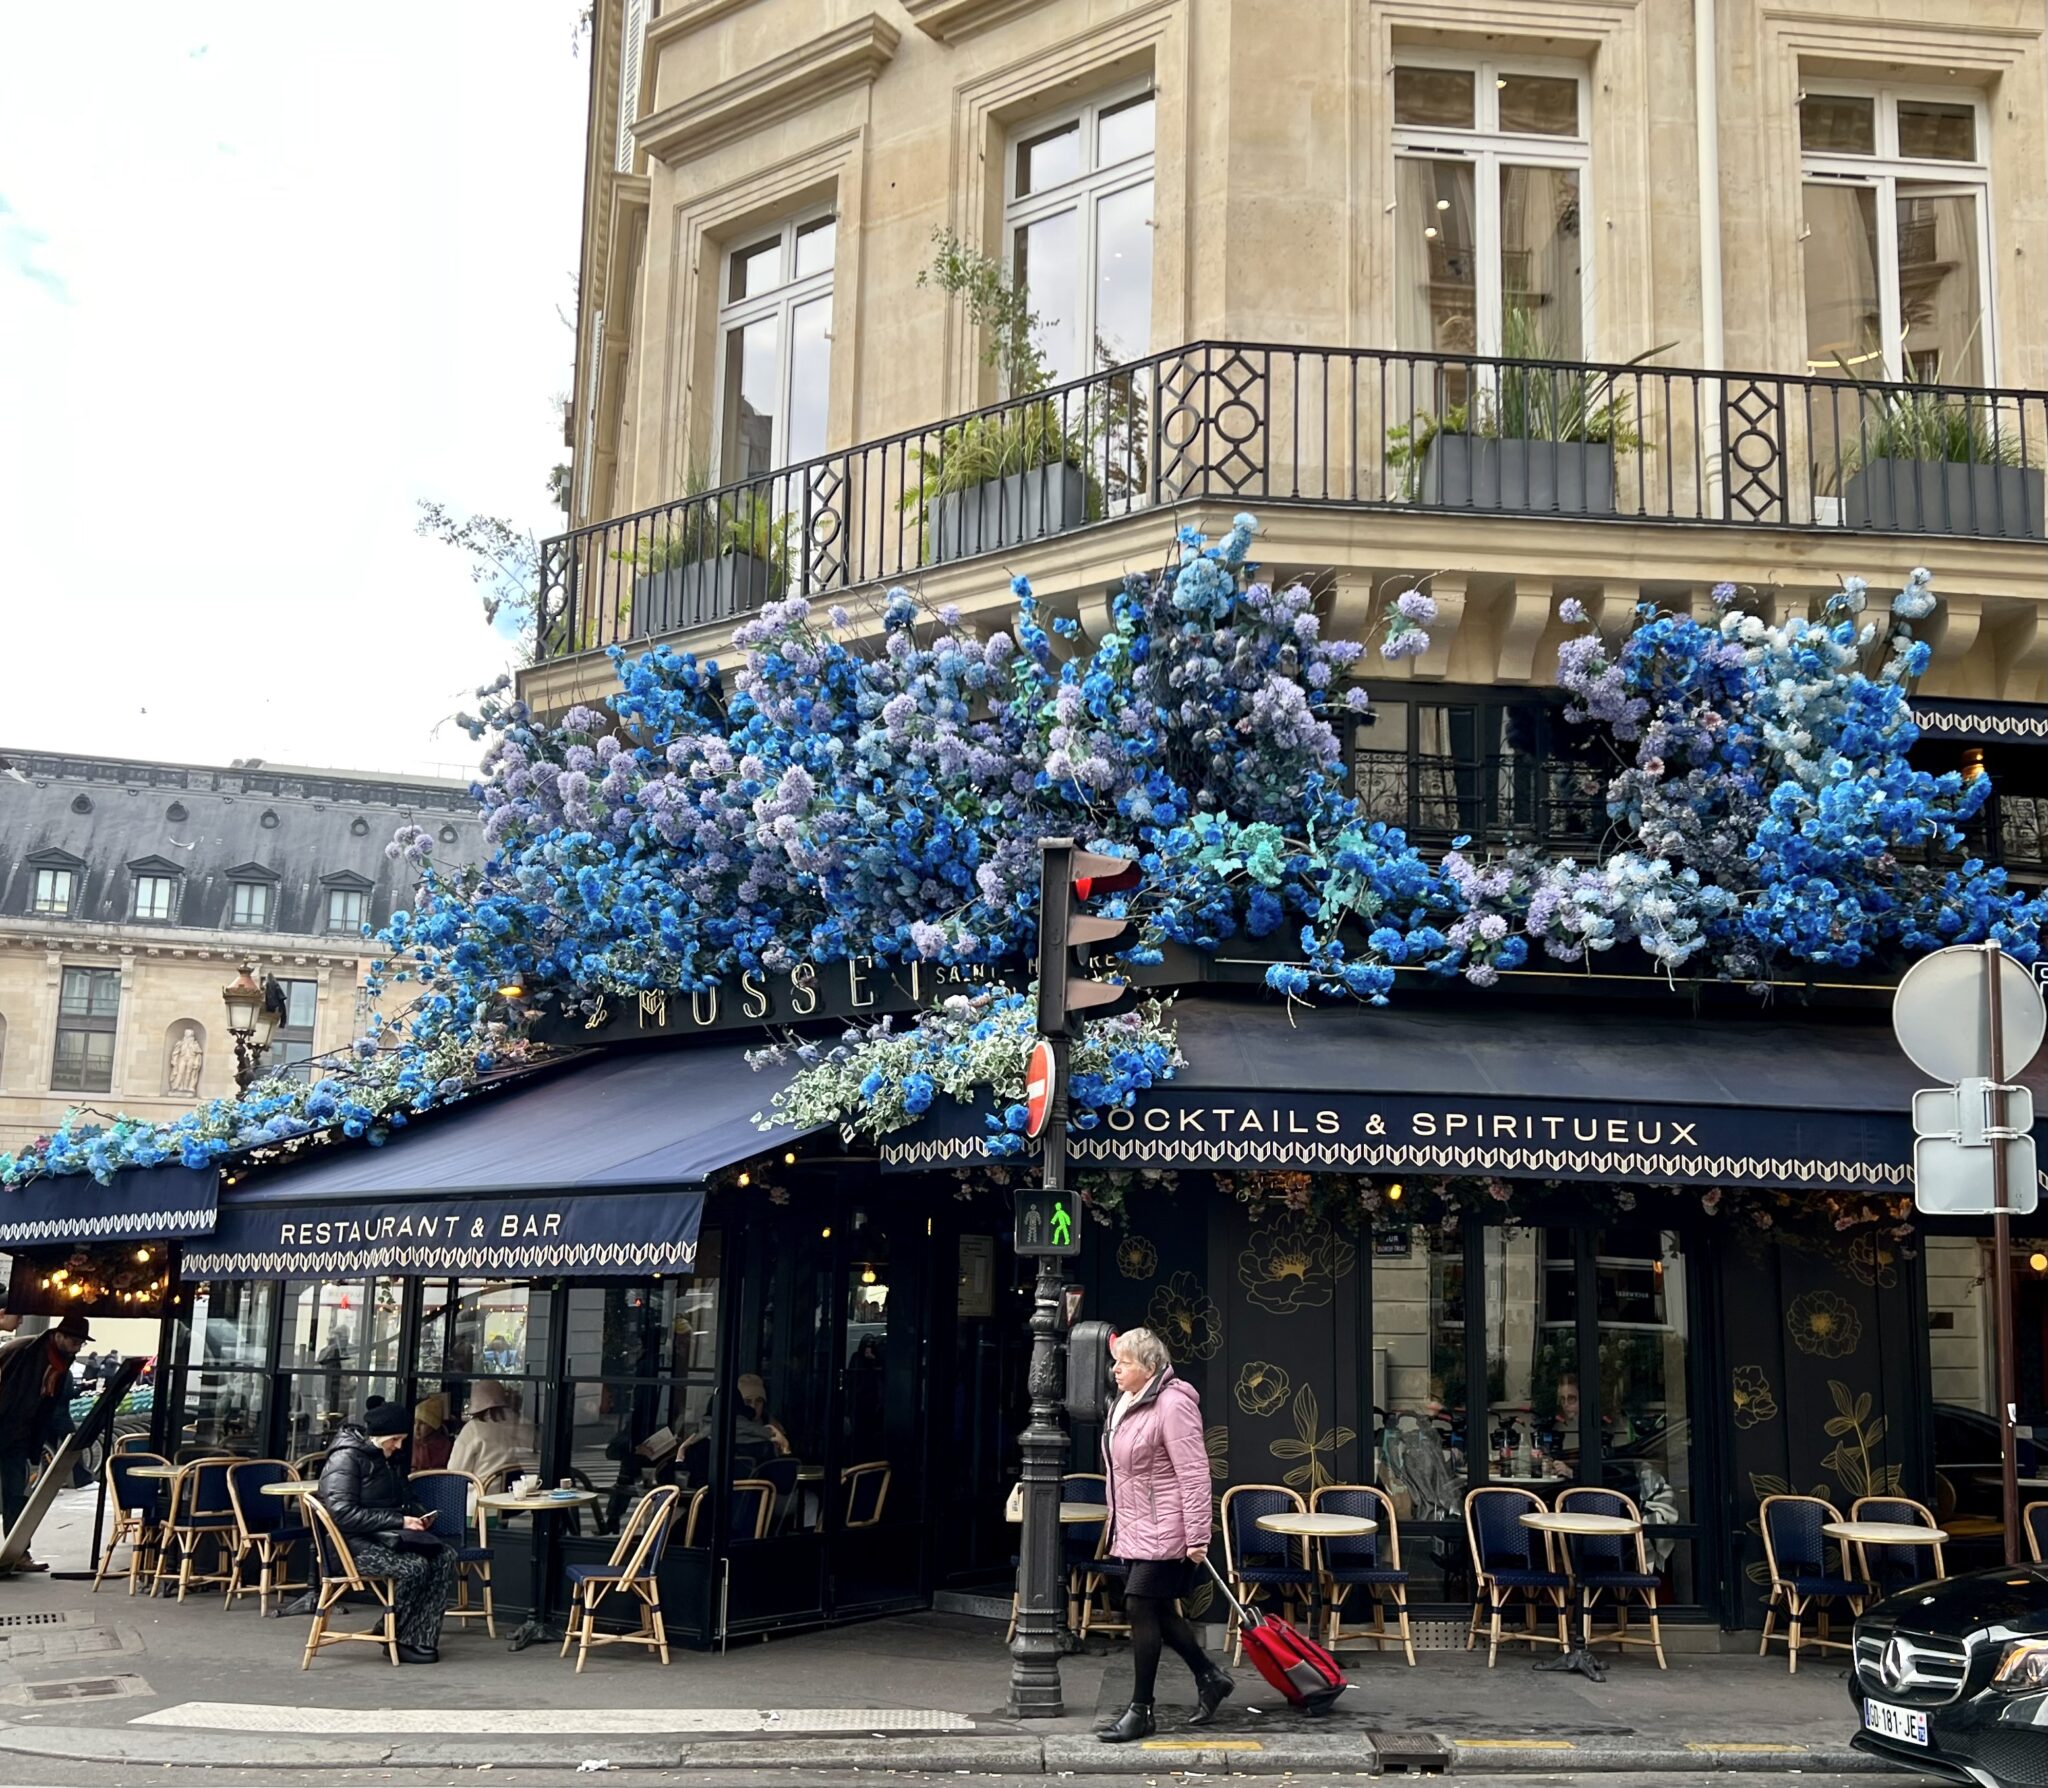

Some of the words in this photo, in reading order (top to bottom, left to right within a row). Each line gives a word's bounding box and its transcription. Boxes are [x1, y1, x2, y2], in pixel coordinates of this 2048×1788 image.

[1071, 1107, 1340, 1134] COCKTAILS
[1365, 1113, 1387, 1136] &
[1411, 1112, 1698, 1146] SPIRITUEUX
[280, 1215, 460, 1245] RESTAURANT
[470, 1217, 485, 1239] &
[500, 1213, 562, 1238] BAR
